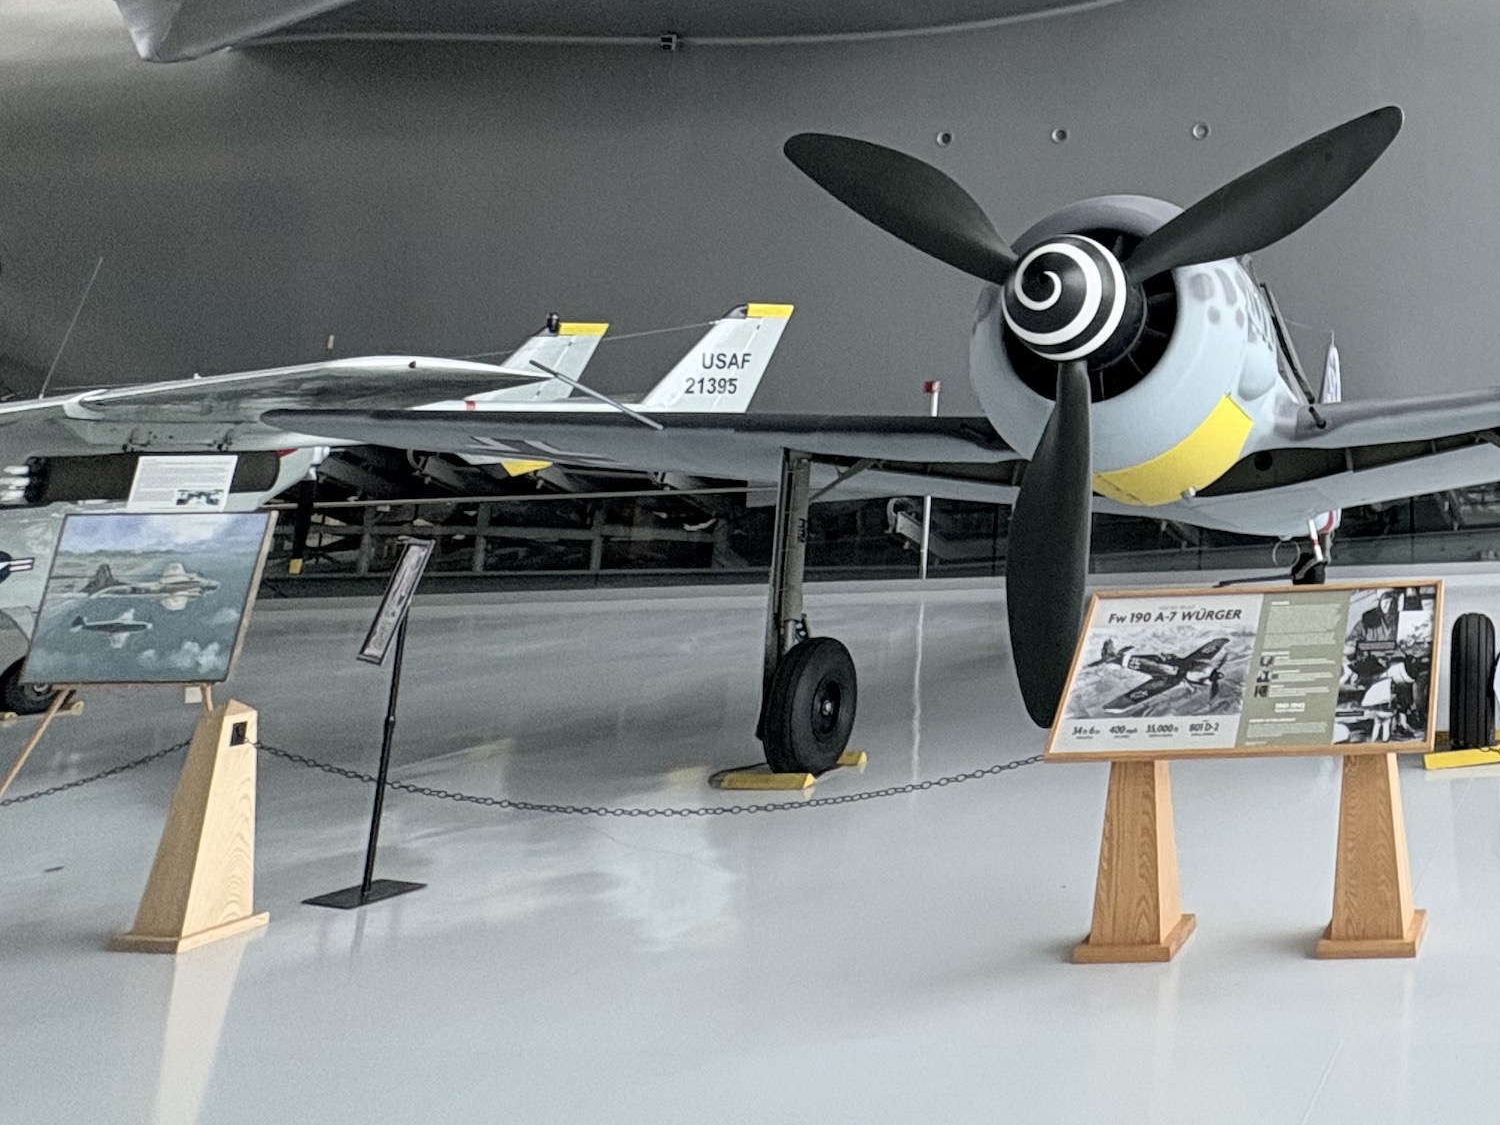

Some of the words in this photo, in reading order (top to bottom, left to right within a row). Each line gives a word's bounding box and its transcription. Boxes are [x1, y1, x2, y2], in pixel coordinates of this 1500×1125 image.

[702, 353, 752, 369] USAF
[684, 377, 738, 394] 21395
[1108, 613, 1126, 624] Fw
[1130, 612, 1151, 623] 190
[1154, 611, 1177, 622] A-7
[1181, 607, 1242, 621] WÜRGER
